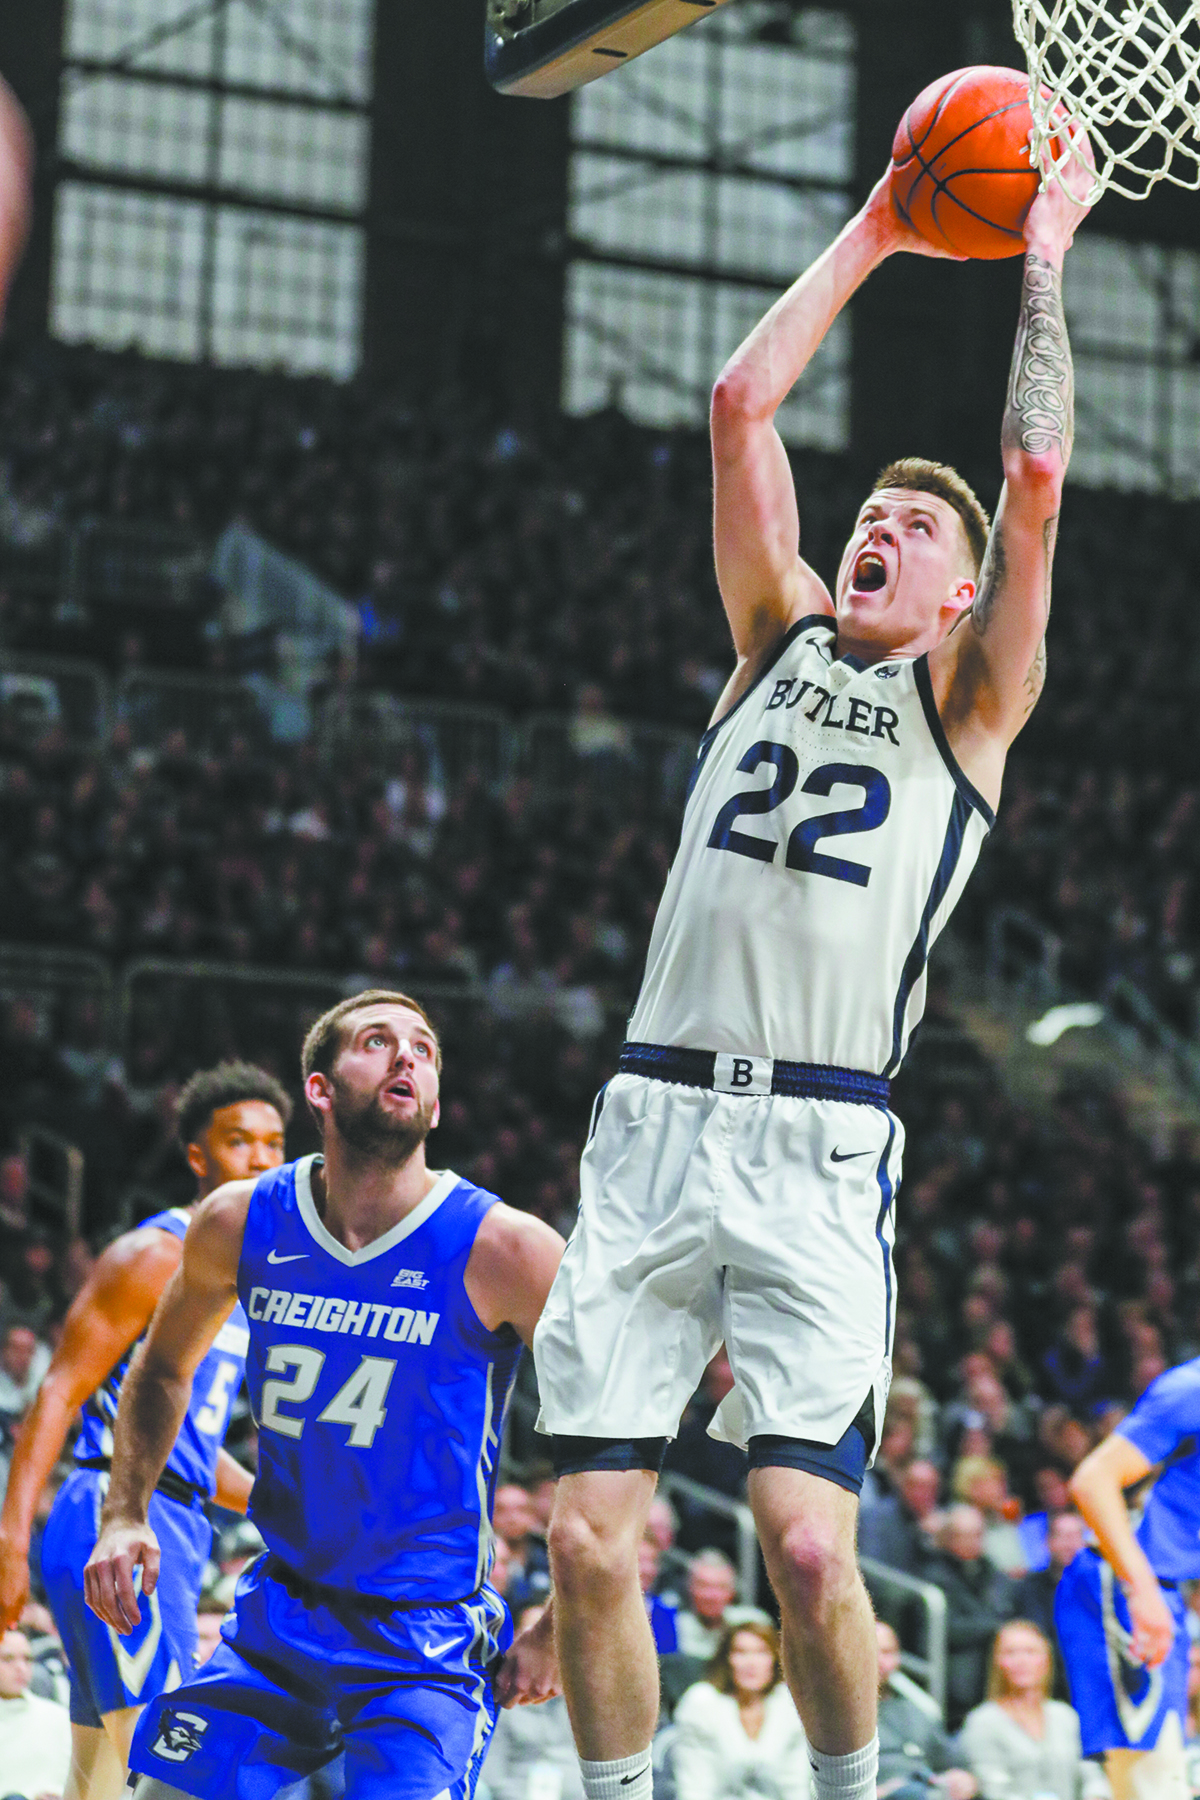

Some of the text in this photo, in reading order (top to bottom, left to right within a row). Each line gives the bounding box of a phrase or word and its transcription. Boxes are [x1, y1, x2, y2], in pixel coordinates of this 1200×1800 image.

[765, 677, 901, 747] BUTLER
[706, 740, 892, 889] 22
[730, 1058, 754, 1088] B
[392, 1276, 430, 1288] EAST
[398, 1268, 426, 1280] BIG
[248, 1286, 440, 1346] CREIGHTON
[194, 1361, 239, 1435] 5
[259, 1343, 398, 1449] 24
